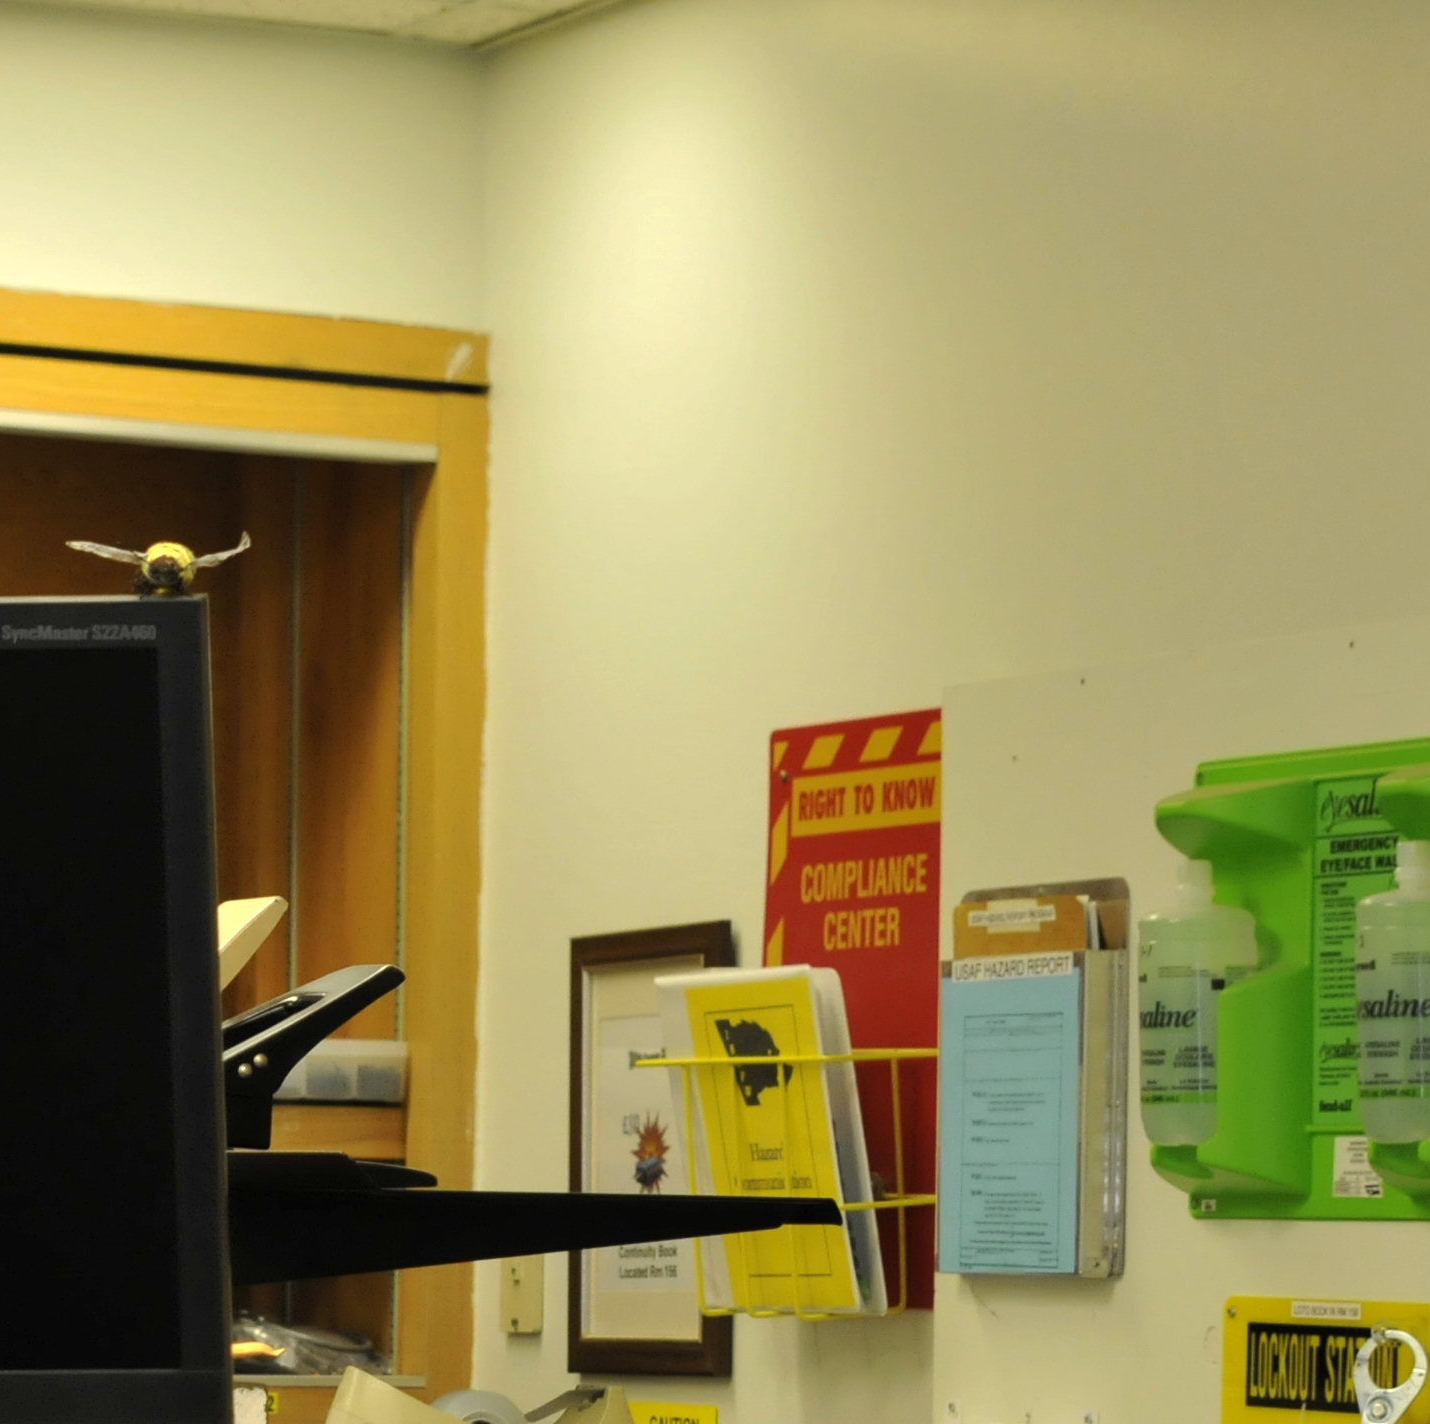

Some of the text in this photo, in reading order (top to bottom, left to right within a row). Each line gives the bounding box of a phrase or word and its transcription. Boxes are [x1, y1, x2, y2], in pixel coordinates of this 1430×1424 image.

[1, 624, 89, 643] SyncMaster
[799, 776, 936, 821] RIGHT TO KNOW
[1330, 835, 1398, 854] EMERGENCY
[800, 853, 928, 904] COMPLIANCE
[823, 907, 900, 951] CENTER
[954, 956, 1070, 980] USAF HAZARD REPORT
[1250, 1332, 1320, 1401] LOCKOUT
